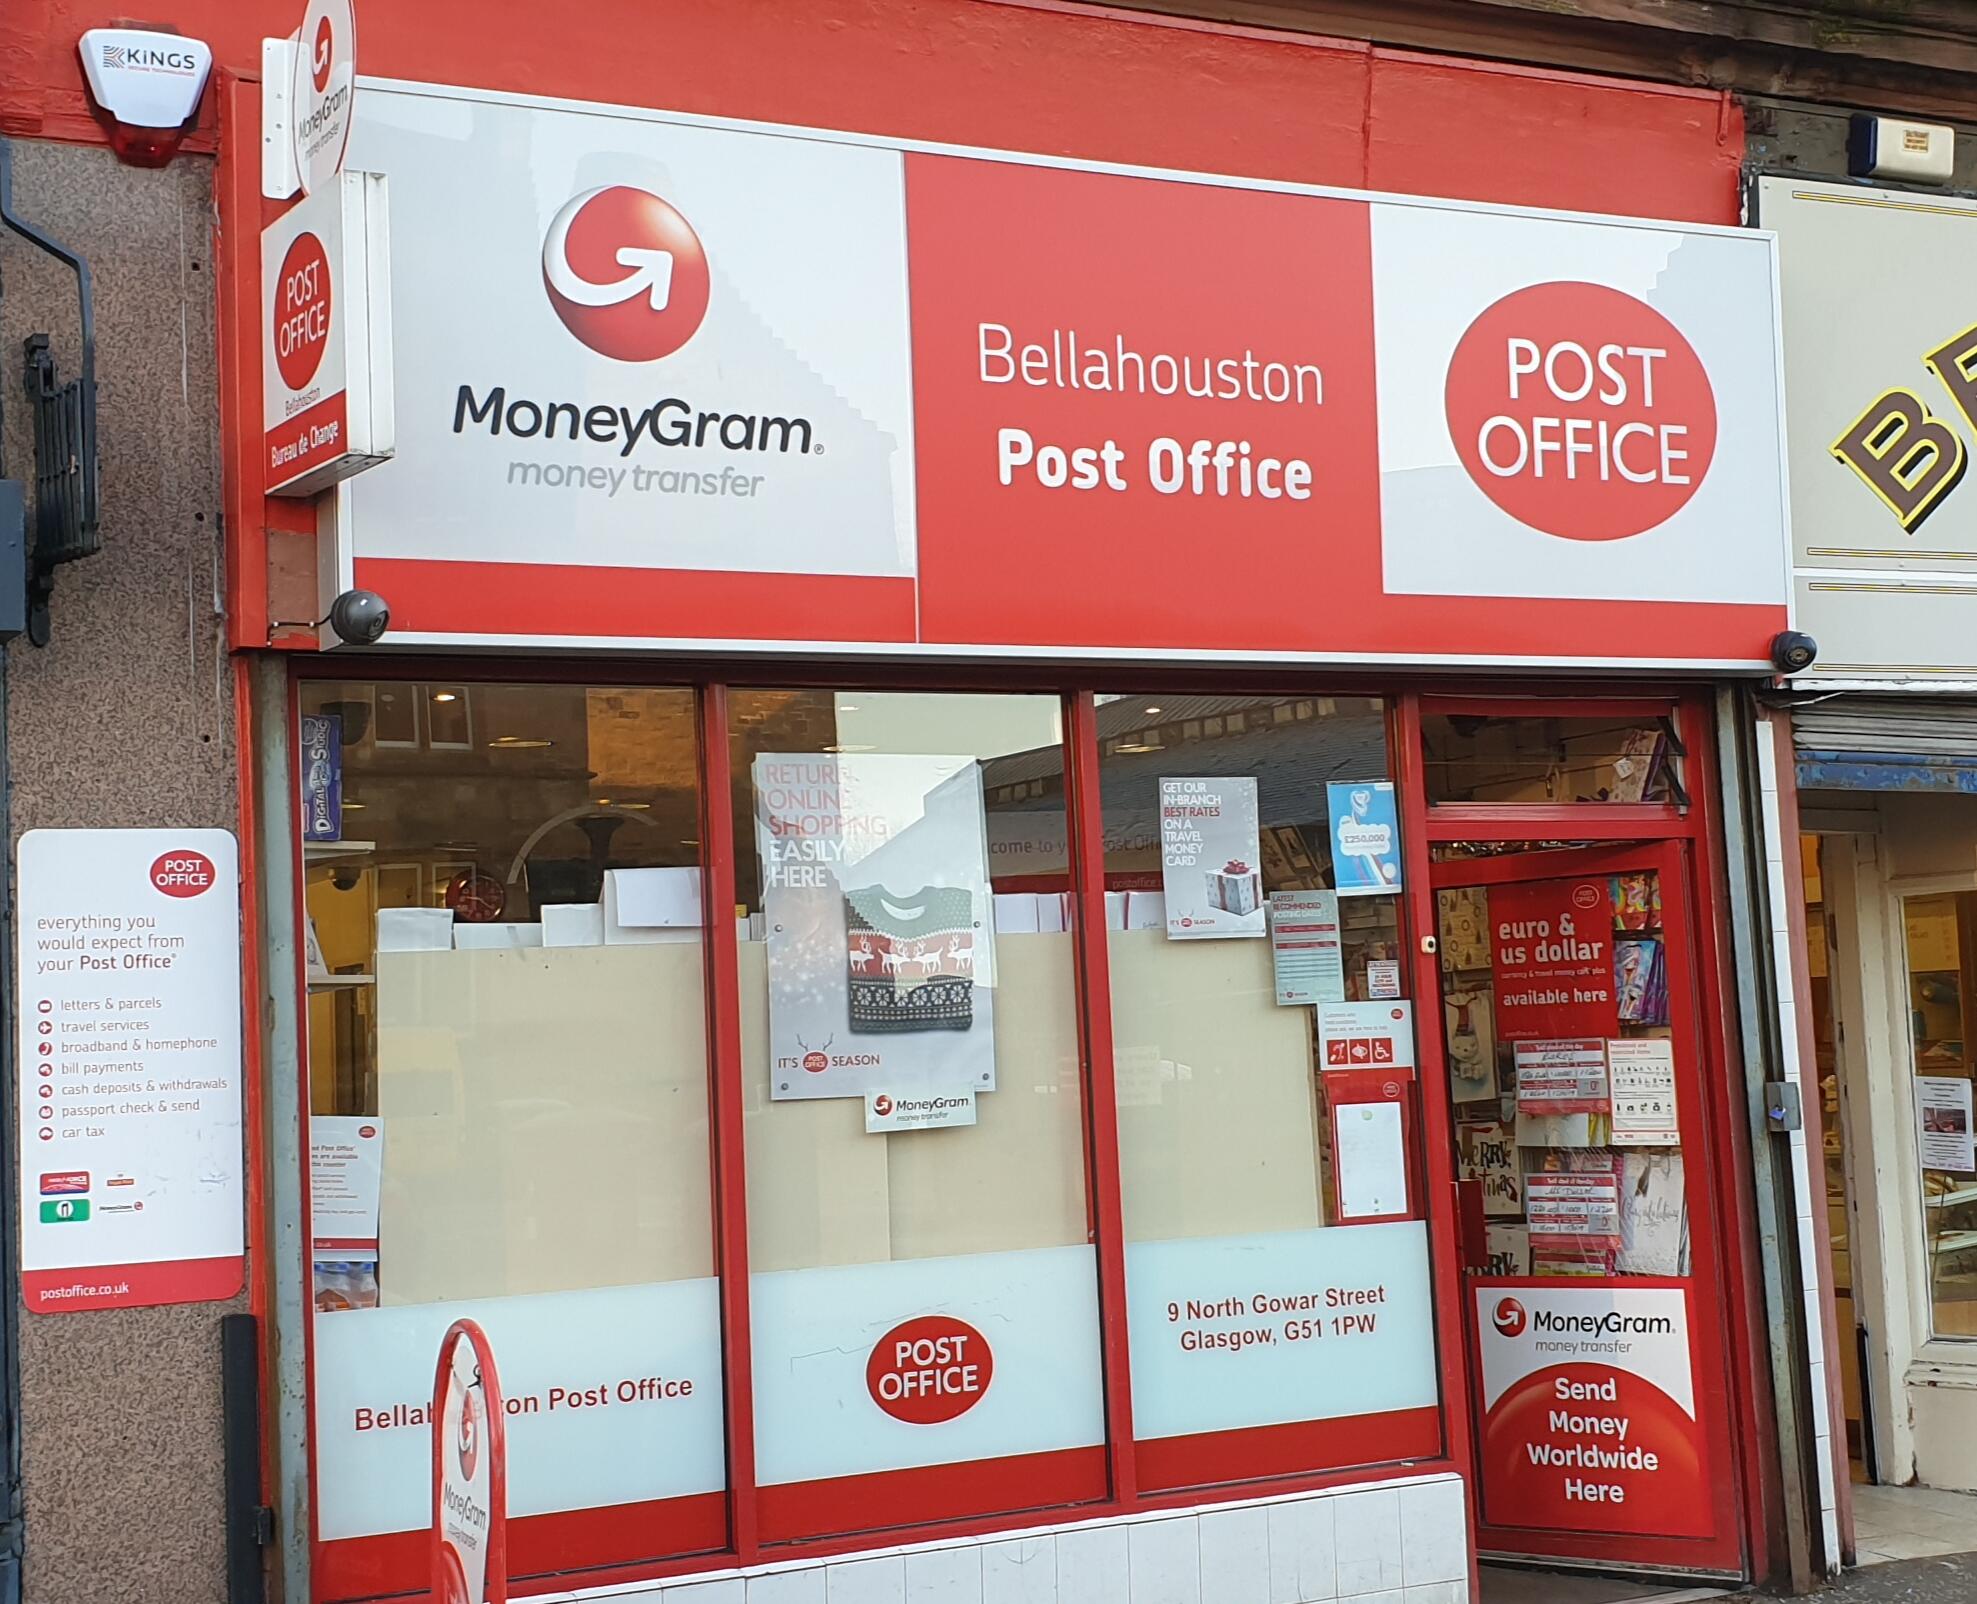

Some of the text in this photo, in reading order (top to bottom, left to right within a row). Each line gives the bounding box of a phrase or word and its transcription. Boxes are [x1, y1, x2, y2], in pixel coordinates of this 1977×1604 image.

[299, 84, 348, 145] MoneyGram
[287, 259, 320, 312] POST
[279, 300, 326, 358] OFFICE
[977, 321, 1324, 405] Bellahouston
[1506, 336, 1668, 408] POST
[453, 384, 813, 457] MoneyGram
[271, 420, 339, 468] Bureau de Change
[1477, 414, 1691, 486] OFFICE
[998, 427, 1314, 500] Post Office
[507, 461, 765, 498] money transfer
[765, 763, 843, 784] RETUR
[1163, 782, 1207, 793] GET OUR
[767, 788, 844, 811] ONLIN
[1163, 795, 1222, 806] IN-BRANCH
[1164, 806, 1221, 818] BEST RATES
[1164, 819, 1193, 830] ON A
[1164, 831, 1203, 842] TRAVEL
[769, 839, 846, 862] EASILY
[1165, 843, 1204, 854] MONEY
[165, 859, 203, 872] POST
[1166, 855, 1197, 867] CARD
[156, 873, 209, 886] OFFICE
[770, 866, 828, 888] HERE
[37, 914, 156, 932] everything you
[1499, 912, 1576, 940] euro &
[37, 934, 185, 952] would expect from
[1501, 938, 1604, 965] us dollar
[37, 954, 172, 974] your Post Office
[60, 996, 162, 1011] letters & parcels
[1503, 987, 1608, 1006] available here
[61, 1019, 150, 1033] travel services
[61, 1036, 218, 1054] broadband & homephone
[61, 1060, 144, 1077] bill payments
[778, 1056, 799, 1069] IT'S
[832, 1053, 881, 1067] SEASON
[61, 1077, 228, 1096] cash deposits & withdrawals
[61, 1098, 201, 1118] passport check & send
[896, 1096, 970, 1112] MoneyGram
[896, 1111, 949, 1122] money transfer
[61, 1126, 105, 1139] car tax
[40, 1281, 130, 1302] postoffice.co.uk
[1167, 1284, 1386, 1322] 9 North Gowar Street
[1180, 1313, 1377, 1352] Glasgow, G51 1PW
[1534, 1310, 1671, 1338] MoneyGram
[895, 1335, 968, 1368] POST
[1535, 1339, 1633, 1355] money transfer
[878, 1364, 979, 1400] OFFICE
[1554, 1376, 1618, 1402] Send
[549, 1384, 609, 1411] Post
[617, 1377, 694, 1403] Office
[1548, 1409, 1629, 1441] Money
[1526, 1442, 1660, 1472] Worldwide
[1564, 1477, 1625, 1504] Here
[444, 1482, 487, 1530] MoneyGram
